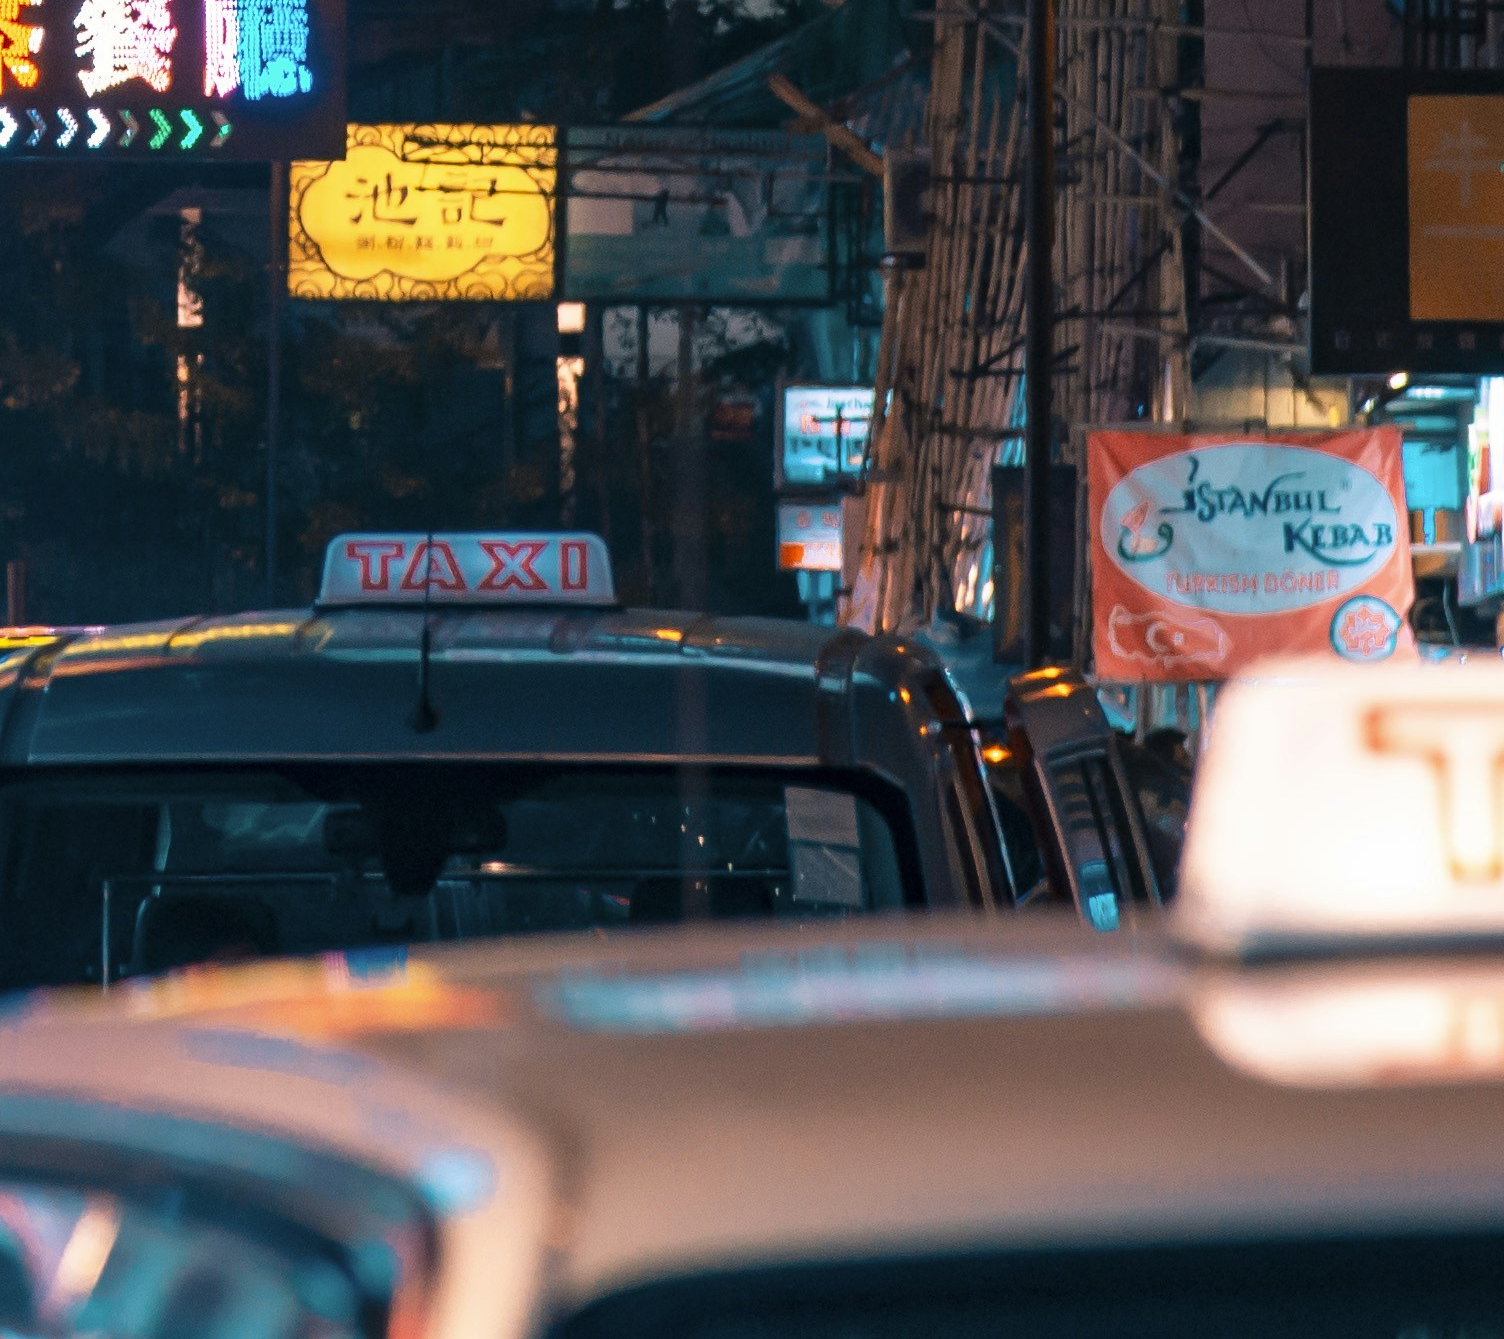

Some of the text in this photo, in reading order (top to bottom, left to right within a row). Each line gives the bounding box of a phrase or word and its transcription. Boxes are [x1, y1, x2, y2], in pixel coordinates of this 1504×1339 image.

[344, 171, 506, 227] 池記
[344, 538, 591, 595] TAXI
[1283, 516, 1394, 566] KEBAB
[1166, 570, 1259, 595] TURKISH
